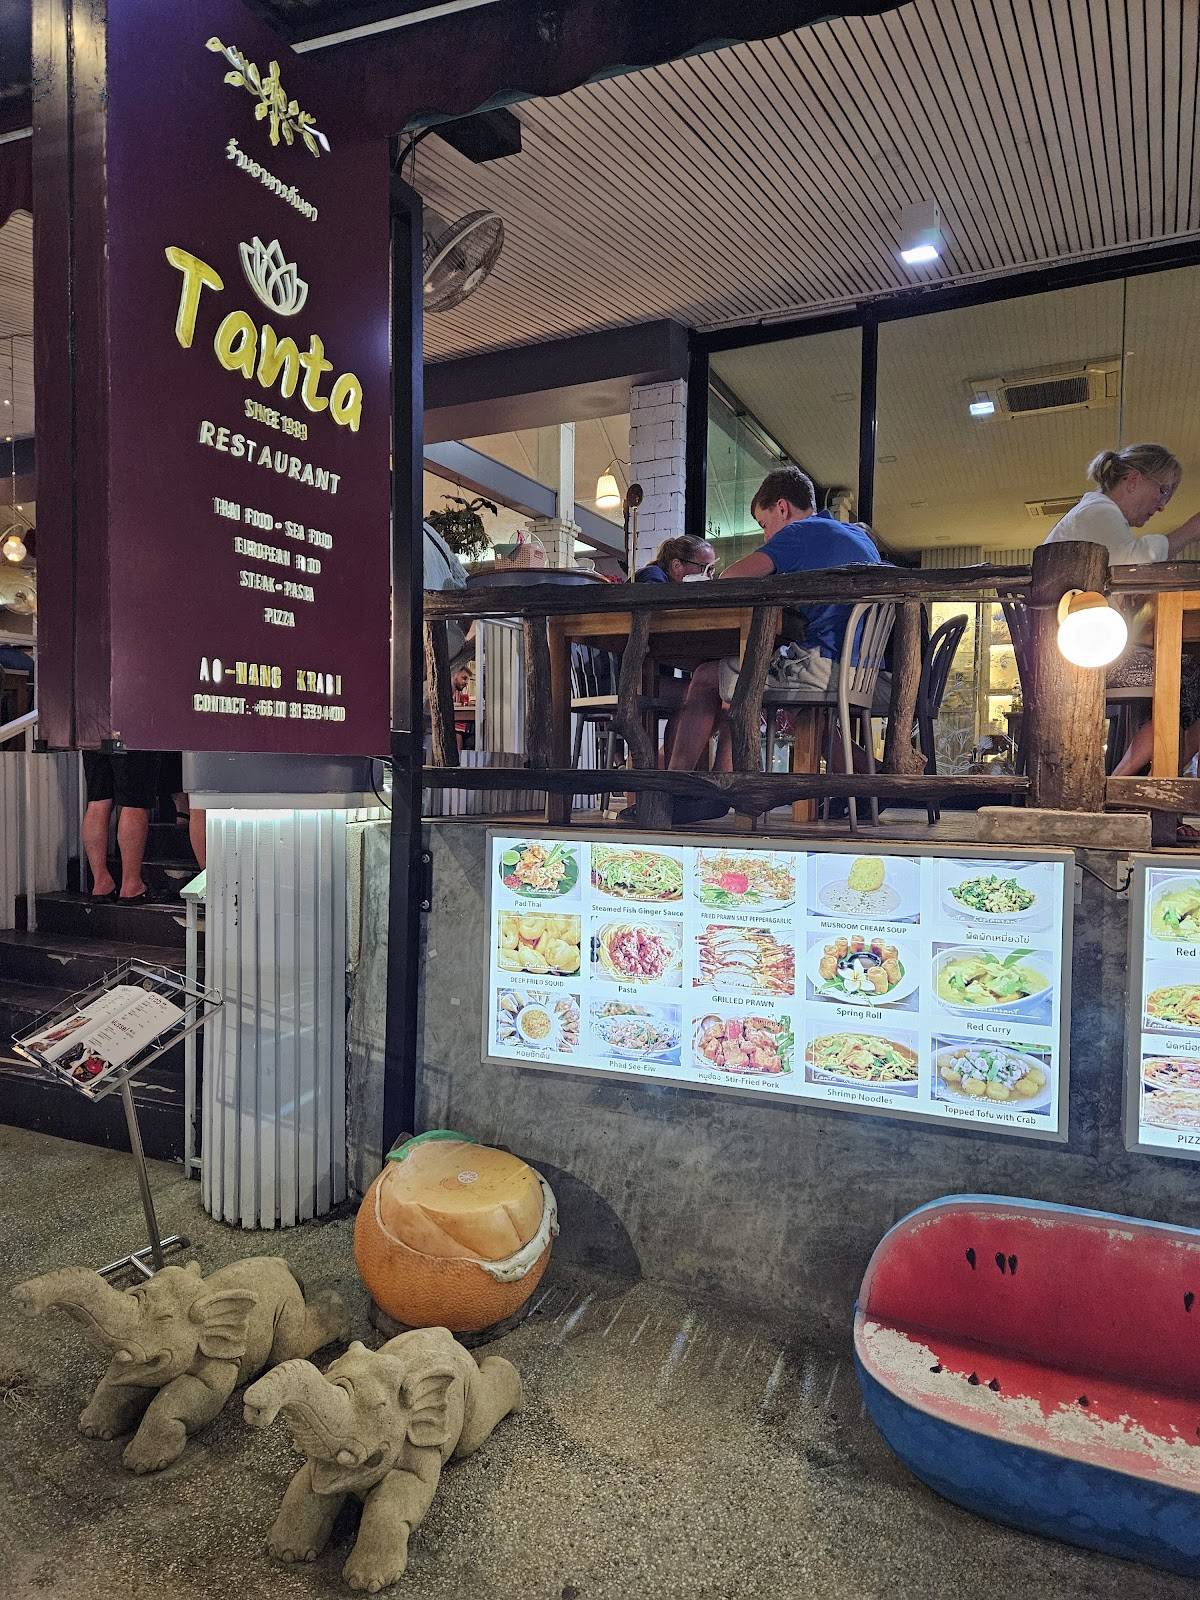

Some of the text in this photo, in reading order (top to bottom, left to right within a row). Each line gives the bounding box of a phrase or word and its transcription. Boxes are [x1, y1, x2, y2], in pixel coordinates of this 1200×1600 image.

[165, 246, 363, 432] Tanta
[244, 399, 308, 441] SINCE 1989
[200, 420, 341, 494] RESTAURANT
[213, 497, 241, 521] THAI
[244, 507, 274, 531] FOOD
[285, 521, 306, 541] SEA
[308, 528, 333, 550] FOOD
[234, 537, 290, 566] EUROPEAN
[240, 570, 275, 592] STEAK
[284, 581, 315, 602] PASTA
[264, 607, 296, 628] PIZZA
[297, 669, 342, 696] KRABI
[528, 900, 542, 908] Thai
[592, 904, 684, 917] Steamed Fish Ginger Sauce
[820, 921, 907, 934] MUSROOM CREAM SOUP
[1176, 947, 1196, 957] Red
[510, 976, 526, 984] DEEP
[544, 979, 564, 987] SQUID
[618, 985, 637, 994] Pasta
[711, 995, 775, 1008] GRILLED PRAWN
[836, 1007, 882, 1019] Spring Roll
[966, 1021, 1011, 1036] Red Curry
[609, 1060, 627, 1069] Phad
[725, 1075, 780, 1088] Stir-Fried Pork
[827, 1088, 893, 1105] Shrimp Noodles
[943, 1104, 1036, 1125] Topped Tofu with Crab
